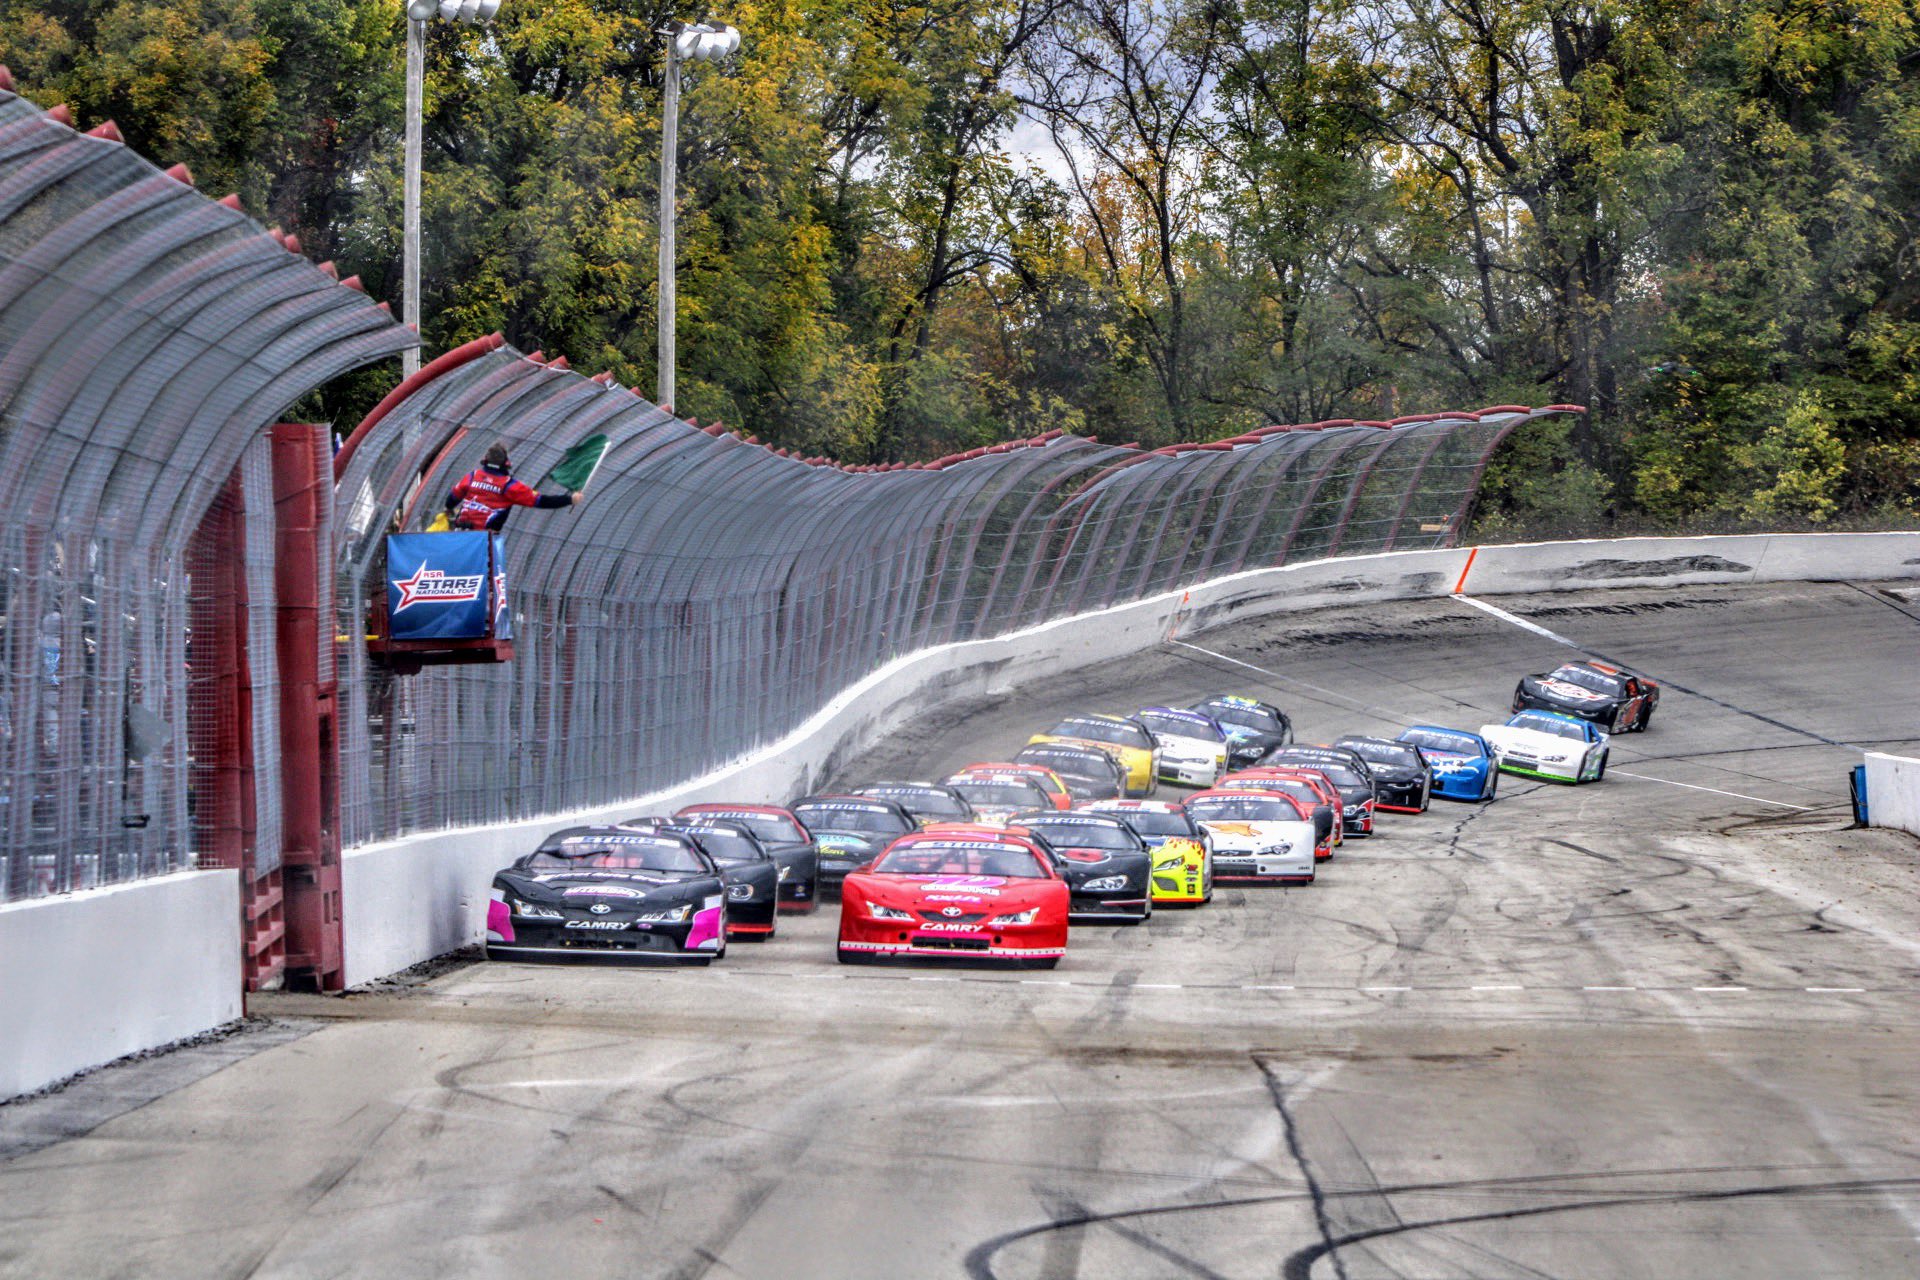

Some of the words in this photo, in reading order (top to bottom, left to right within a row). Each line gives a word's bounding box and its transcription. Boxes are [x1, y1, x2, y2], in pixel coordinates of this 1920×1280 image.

[417, 578, 479, 589] STARS
[565, 920, 631, 930] CAMRY
[920, 922, 984, 932] CAMRY
